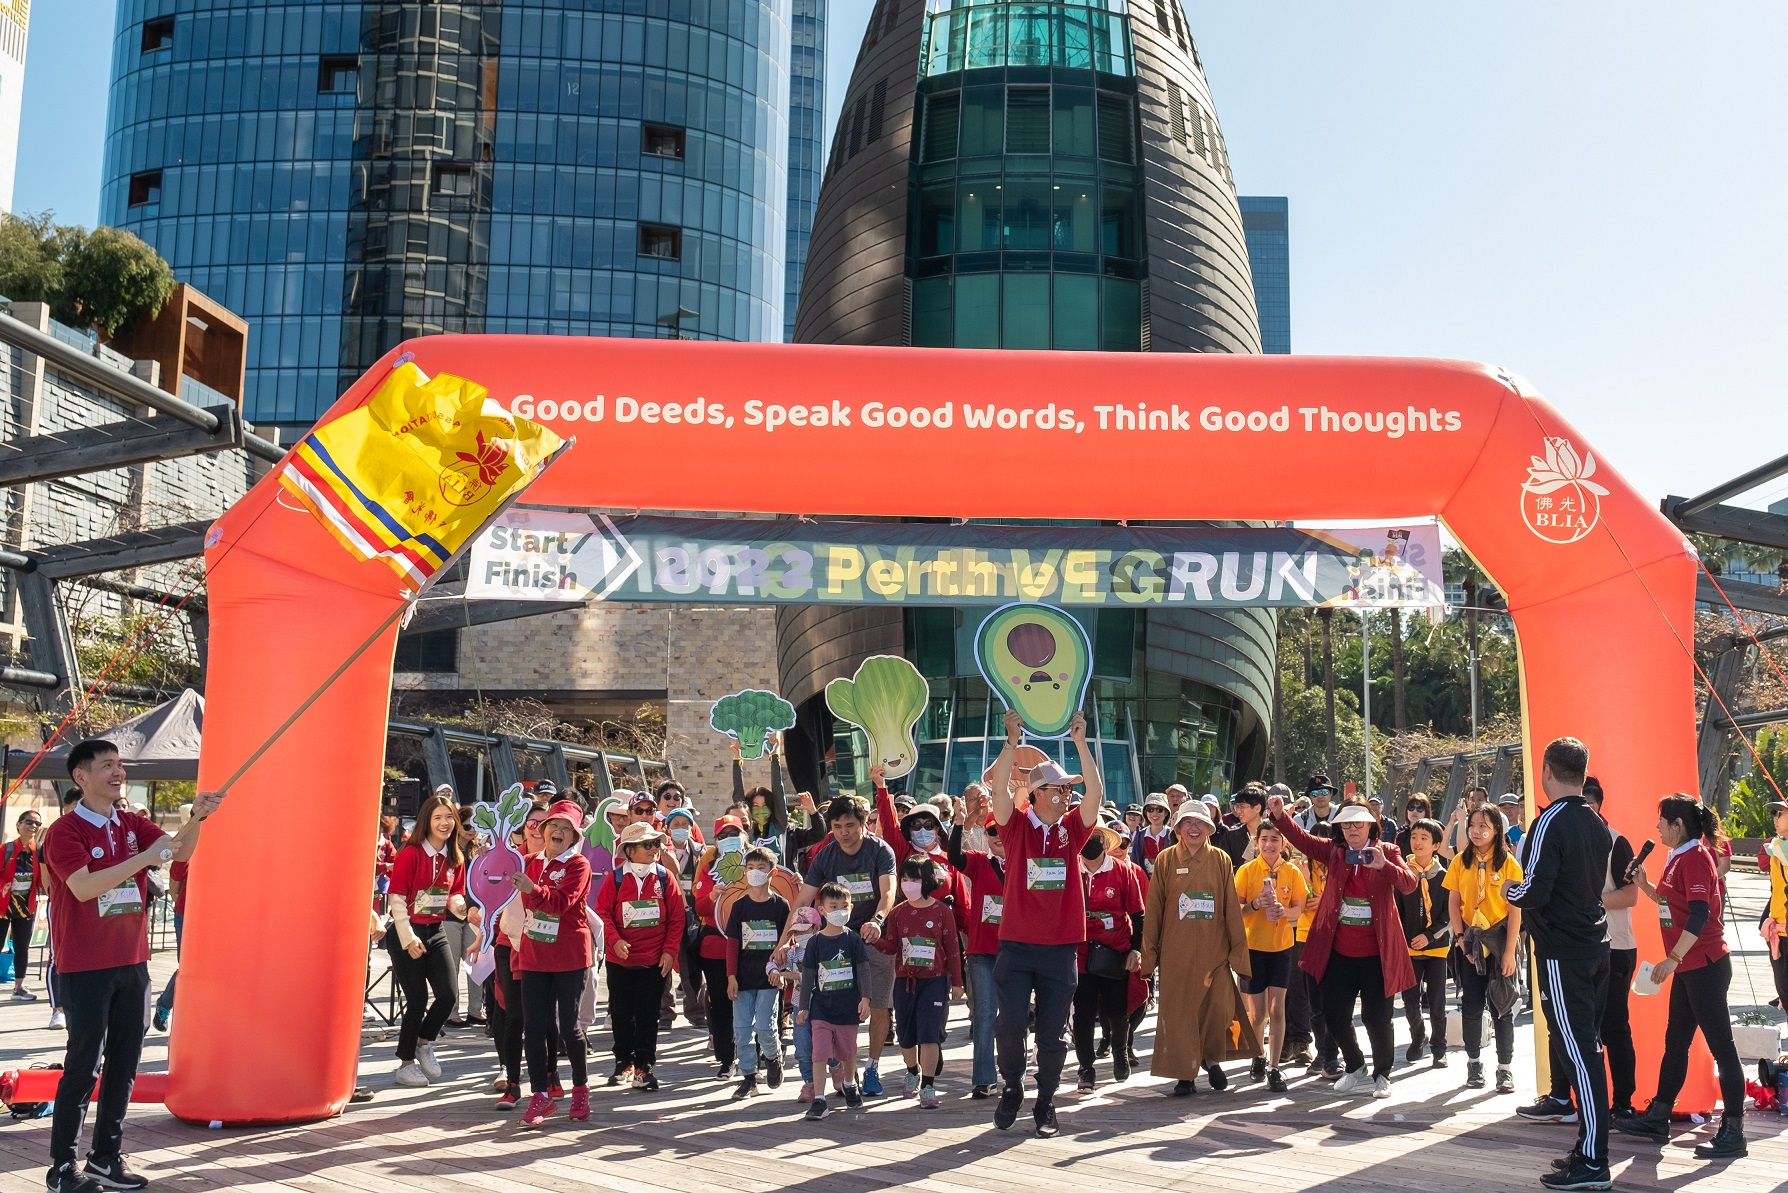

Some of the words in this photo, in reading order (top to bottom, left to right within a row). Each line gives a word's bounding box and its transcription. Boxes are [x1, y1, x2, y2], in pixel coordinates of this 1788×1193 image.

[510, 394, 605, 423] Good
[615, 396, 735, 429] Deeds,
[744, 399, 852, 432] Speak
[860, 401, 953, 429] Good
[963, 403, 1085, 434] Words,
[1093, 402, 1191, 431] Think
[1200, 405, 1290, 433] Good
[1298, 405, 1463, 439] Thoughts
[1535, 496, 1577, 512] 佛光
[1535, 513, 1589, 529] BLIA
[484, 561, 578, 590] Finish
[654, 546, 814, 590] 2022
[827, 546, 998, 597] Perth
[1011, 548, 1166, 604] VEG
[1168, 551, 1318, 601] RUN
